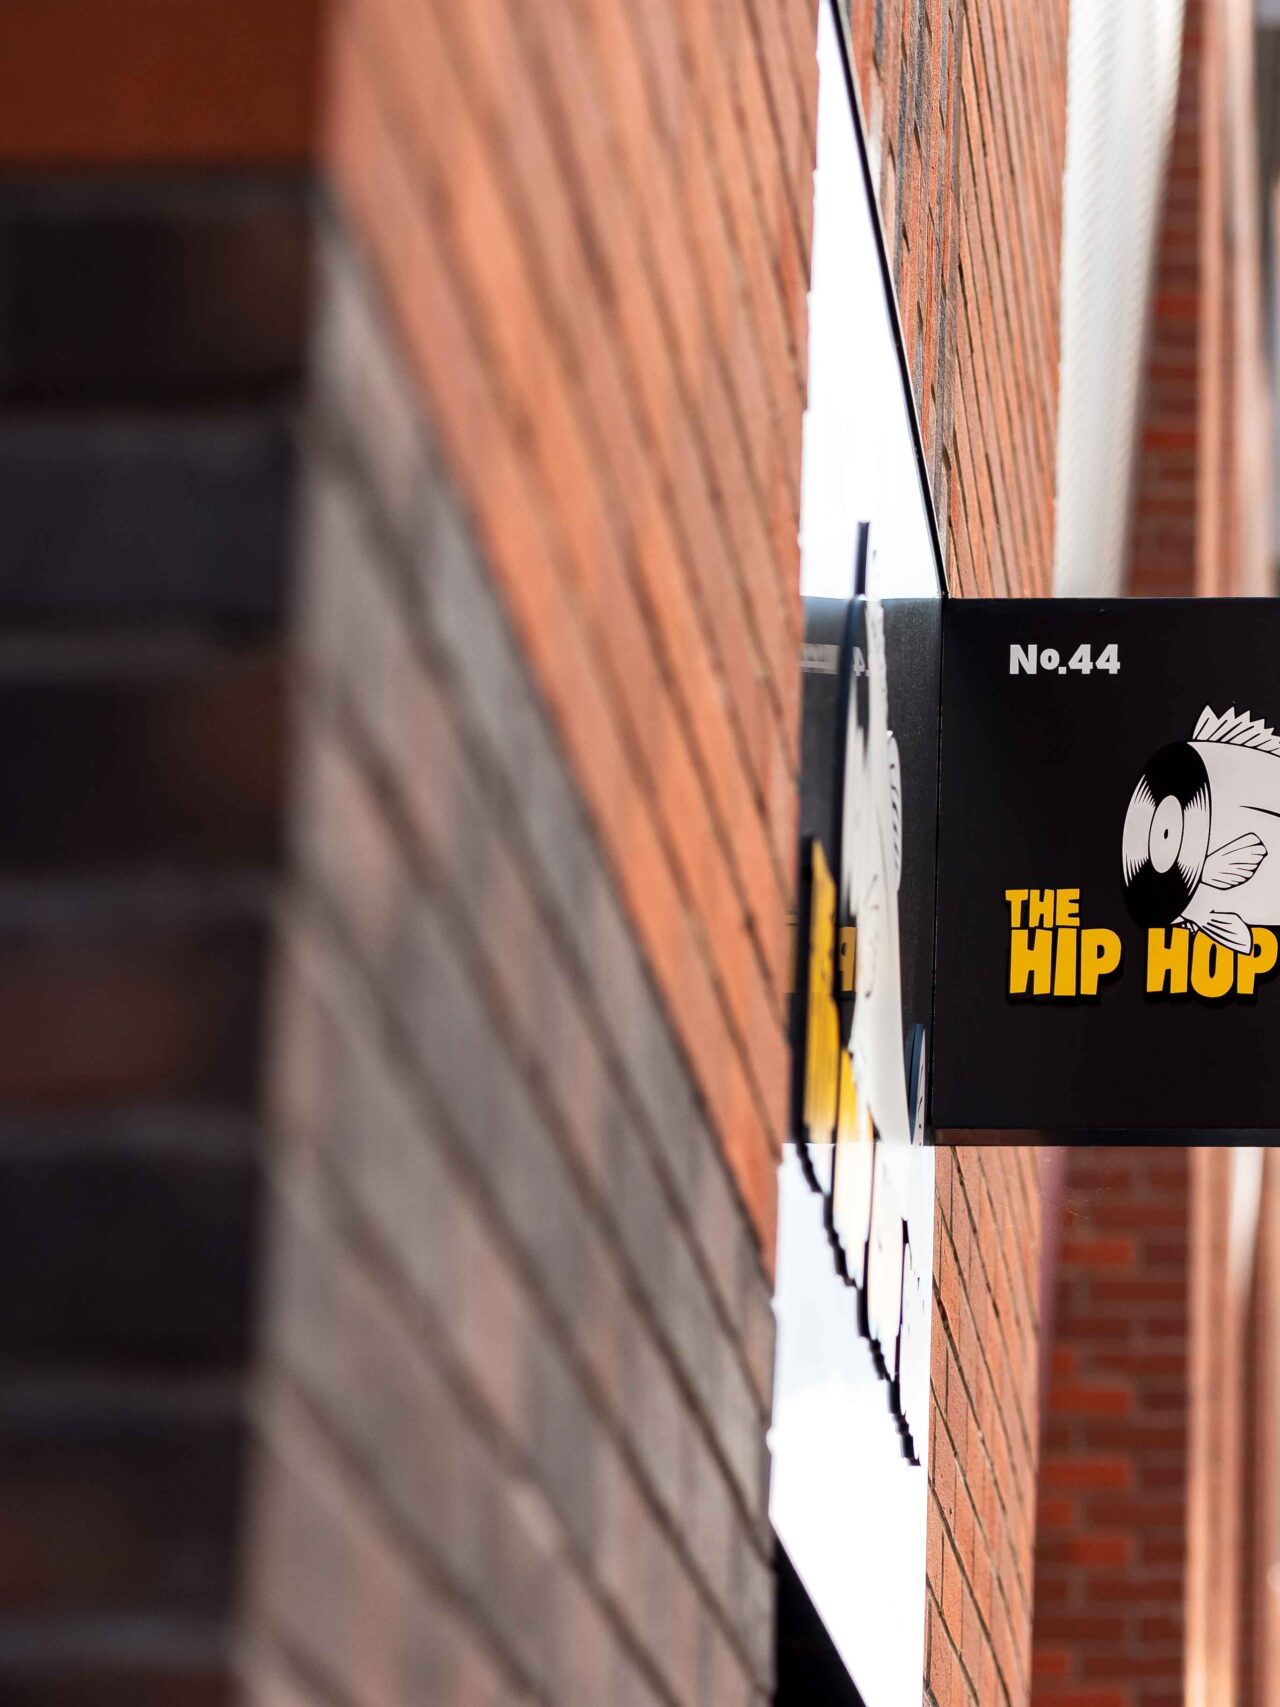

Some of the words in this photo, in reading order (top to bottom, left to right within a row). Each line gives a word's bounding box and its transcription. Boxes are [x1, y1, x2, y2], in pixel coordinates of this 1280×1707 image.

[1009, 643, 1121, 675] No.44
[1005, 888, 1081, 928] THE
[1009, 927, 1122, 997] HIP
[1146, 927, 1279, 998] HOP
